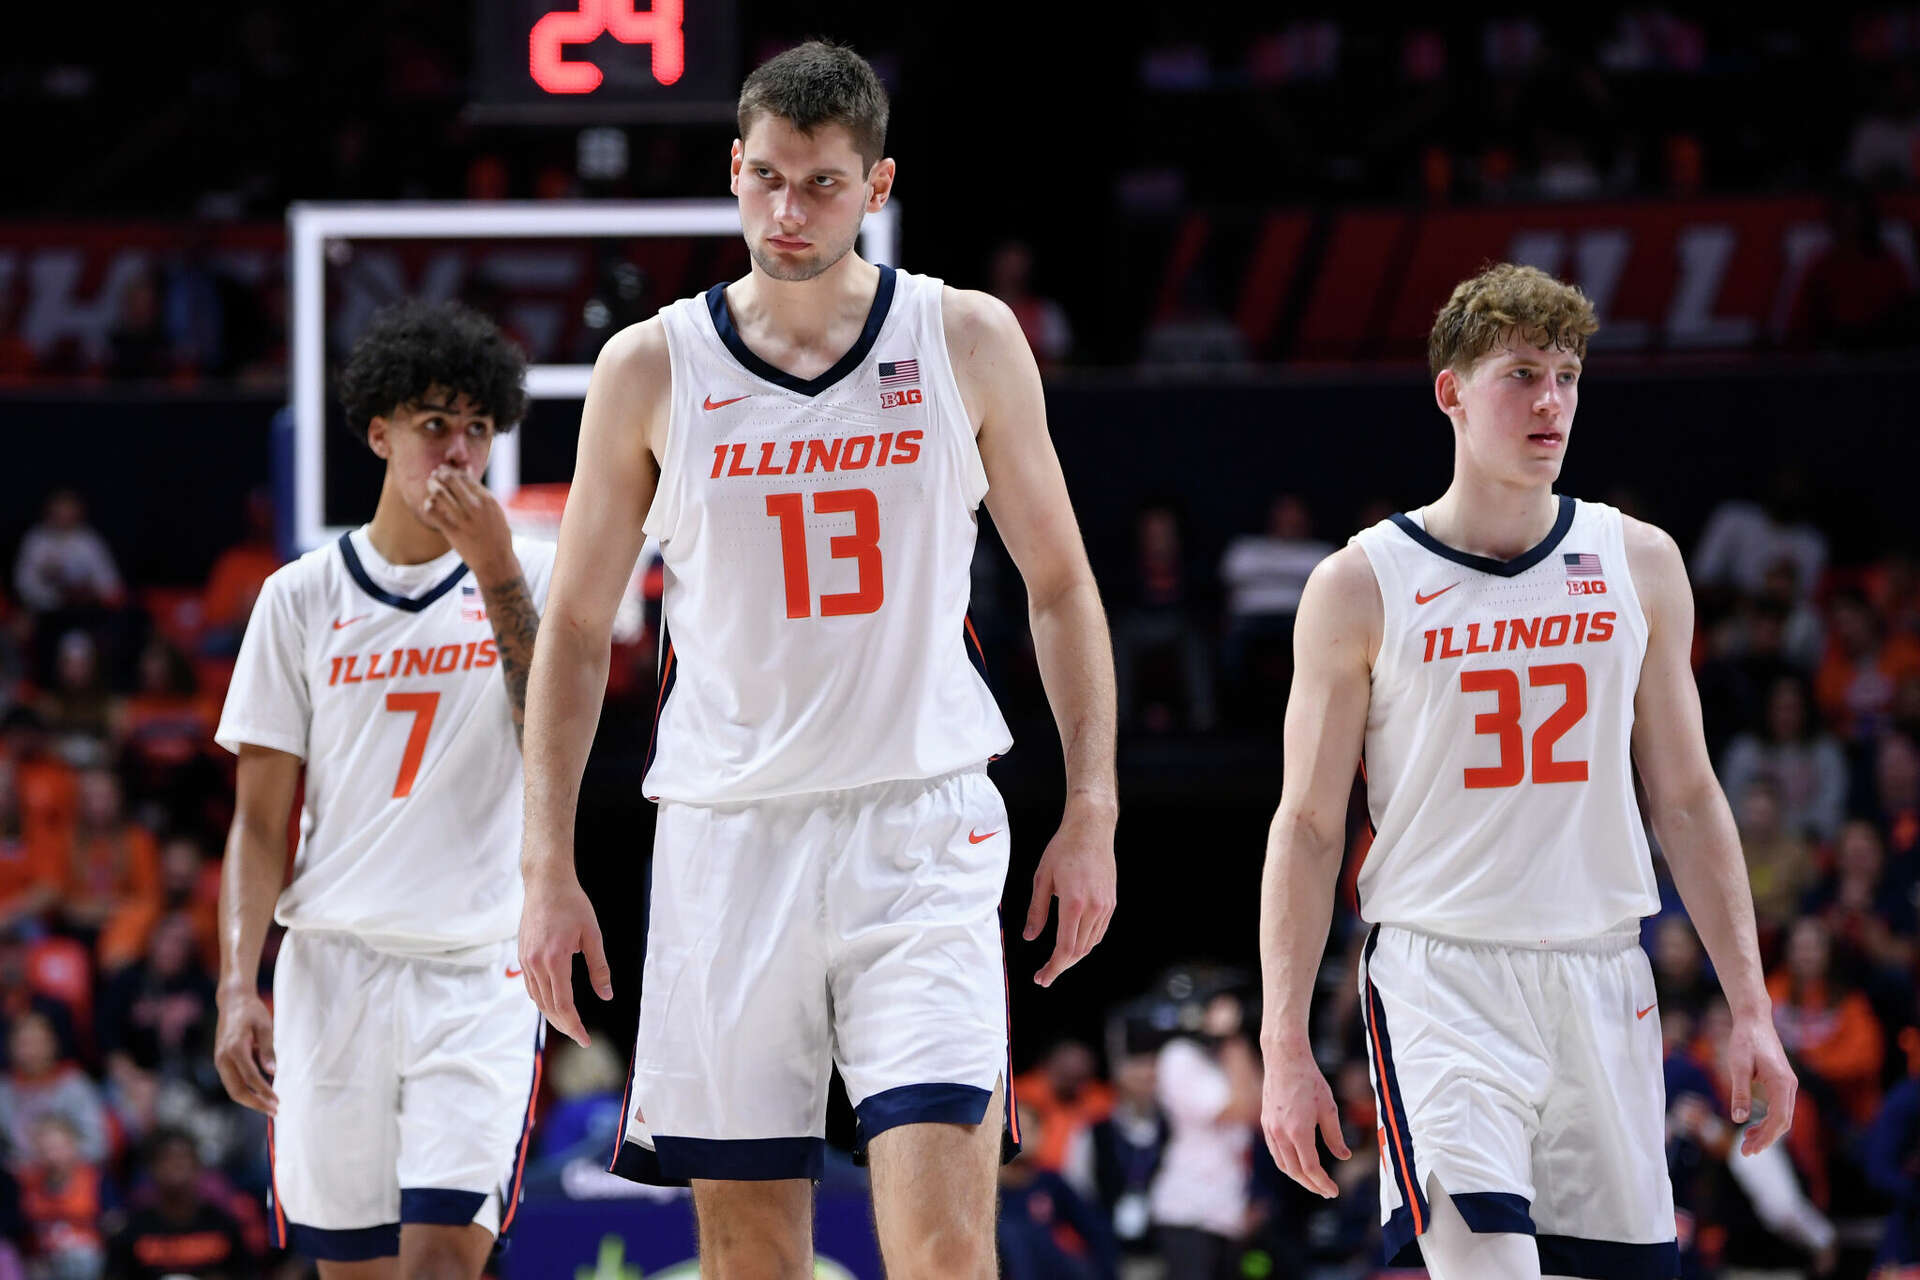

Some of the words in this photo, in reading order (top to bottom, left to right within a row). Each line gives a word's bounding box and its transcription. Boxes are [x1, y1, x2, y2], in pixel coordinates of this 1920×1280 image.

[529, 0, 685, 94] 24
[710, 430, 924, 479] ILLINOIS
[765, 488, 884, 619] 13
[329, 638, 498, 686] ILLINOIS
[1423, 611, 1617, 663] ILLINOIS
[386, 691, 441, 799] 7
[1460, 662, 1589, 790] 32
